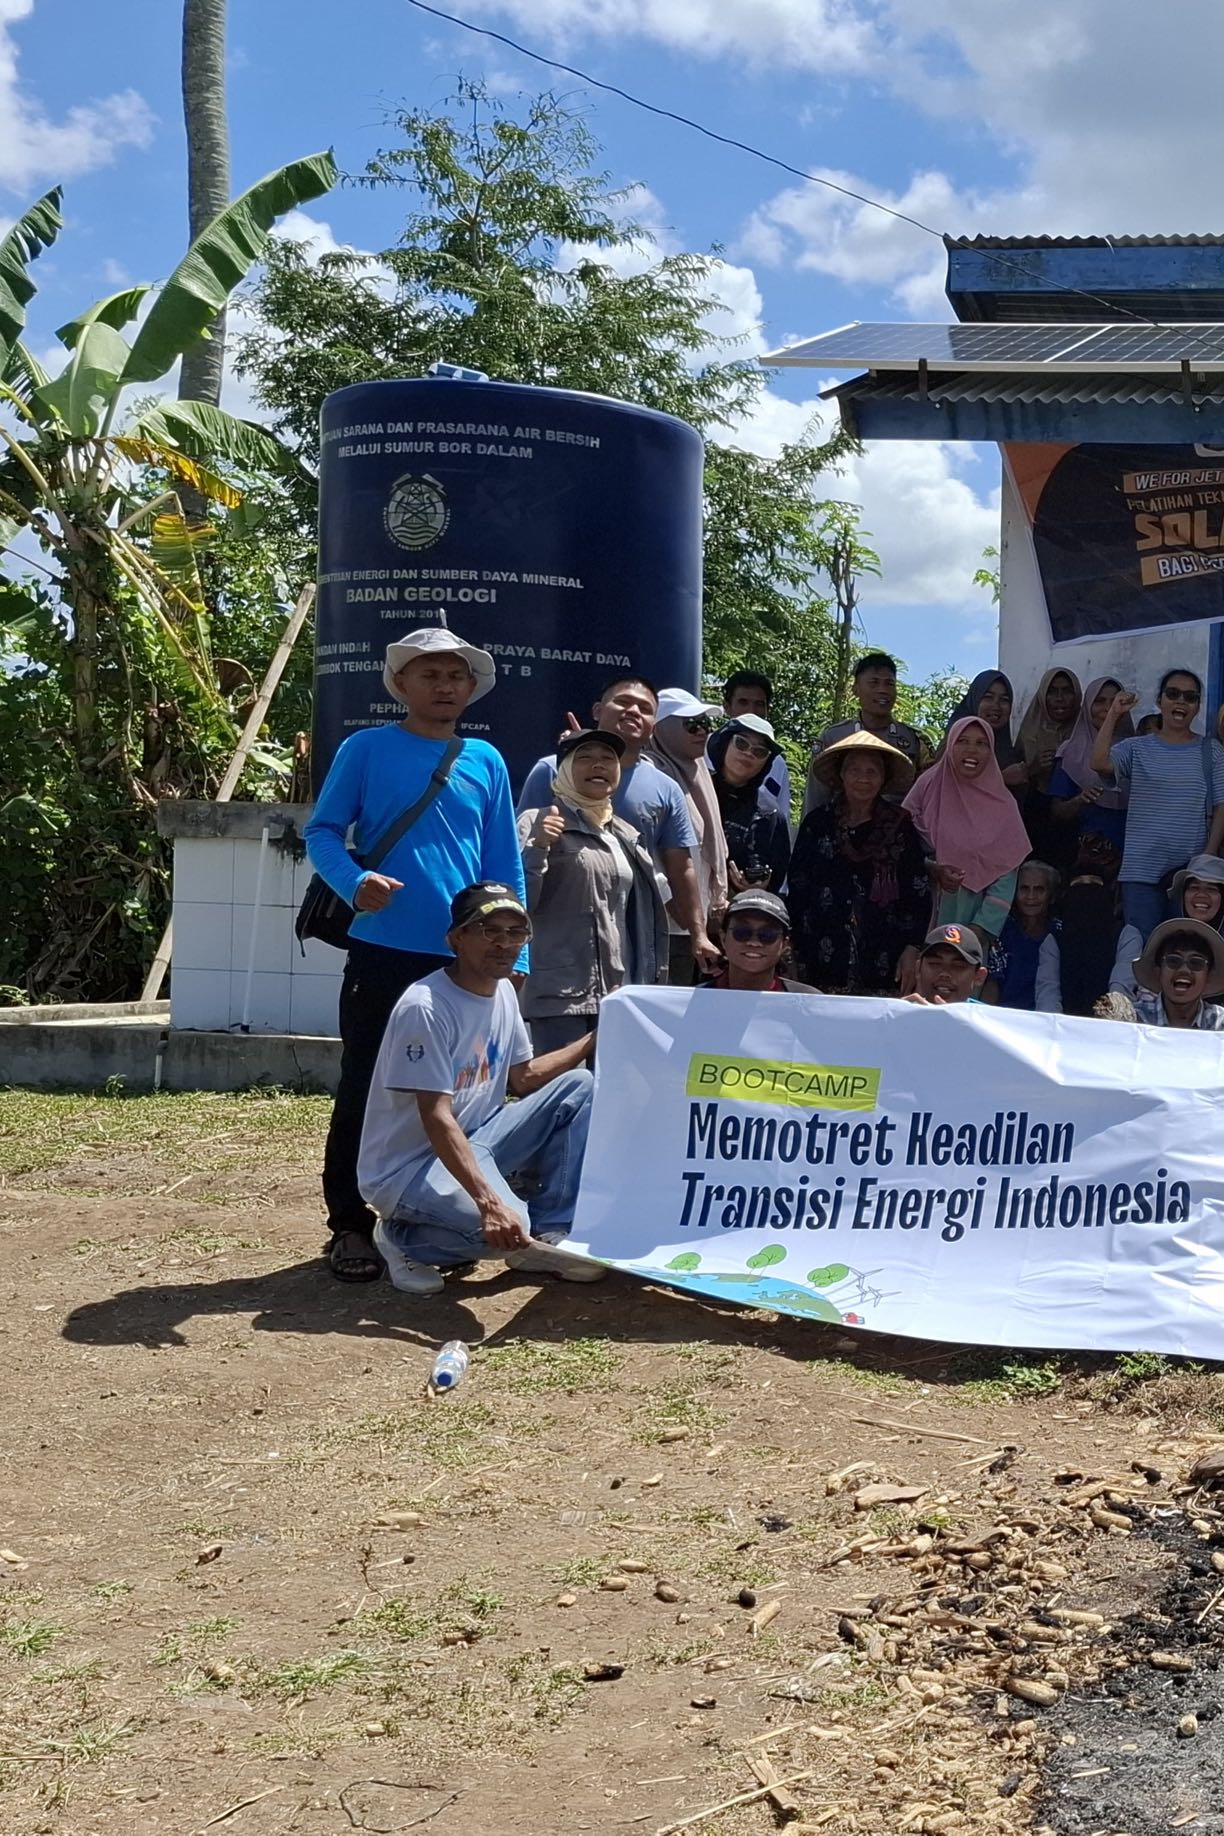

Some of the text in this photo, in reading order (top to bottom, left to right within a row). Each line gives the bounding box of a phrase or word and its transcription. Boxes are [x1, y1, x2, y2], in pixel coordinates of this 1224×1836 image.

[343, 423, 384, 437] SARANA
[387, 422, 413, 434] DAN
[417, 422, 509, 437] PRASARANA
[513, 426, 541, 440] AIR
[545, 430, 600, 448] BERSIH
[338, 442, 532, 459] MELALUI SUMUR BOR DALAM
[1136, 470, 1223, 490] WE FOR JET
[1127, 494, 1193, 513] PELATIHAN
[1158, 556, 1198, 578] BAGI
[353, 569, 389, 581] ENERGI
[393, 569, 417, 580] DAN
[421, 569, 478, 580] SUMBER
[482, 571, 518, 583] DAYA
[522, 573, 584, 589] MINERAL
[346, 587, 496, 603] BADAN GEOLOGI
[380, 609, 416, 619] TAHUN
[339, 642, 371, 655] INDAH
[483, 643, 632, 668] PRAYA BARAT DAYA
[501, 664, 532, 677] T B
[700, 1063, 868, 1098] BOOTCAMP
[686, 1102, 1075, 1166] Memotret Keadilan
[680, 1168, 1190, 1242] Transisi Energi Indonesia
